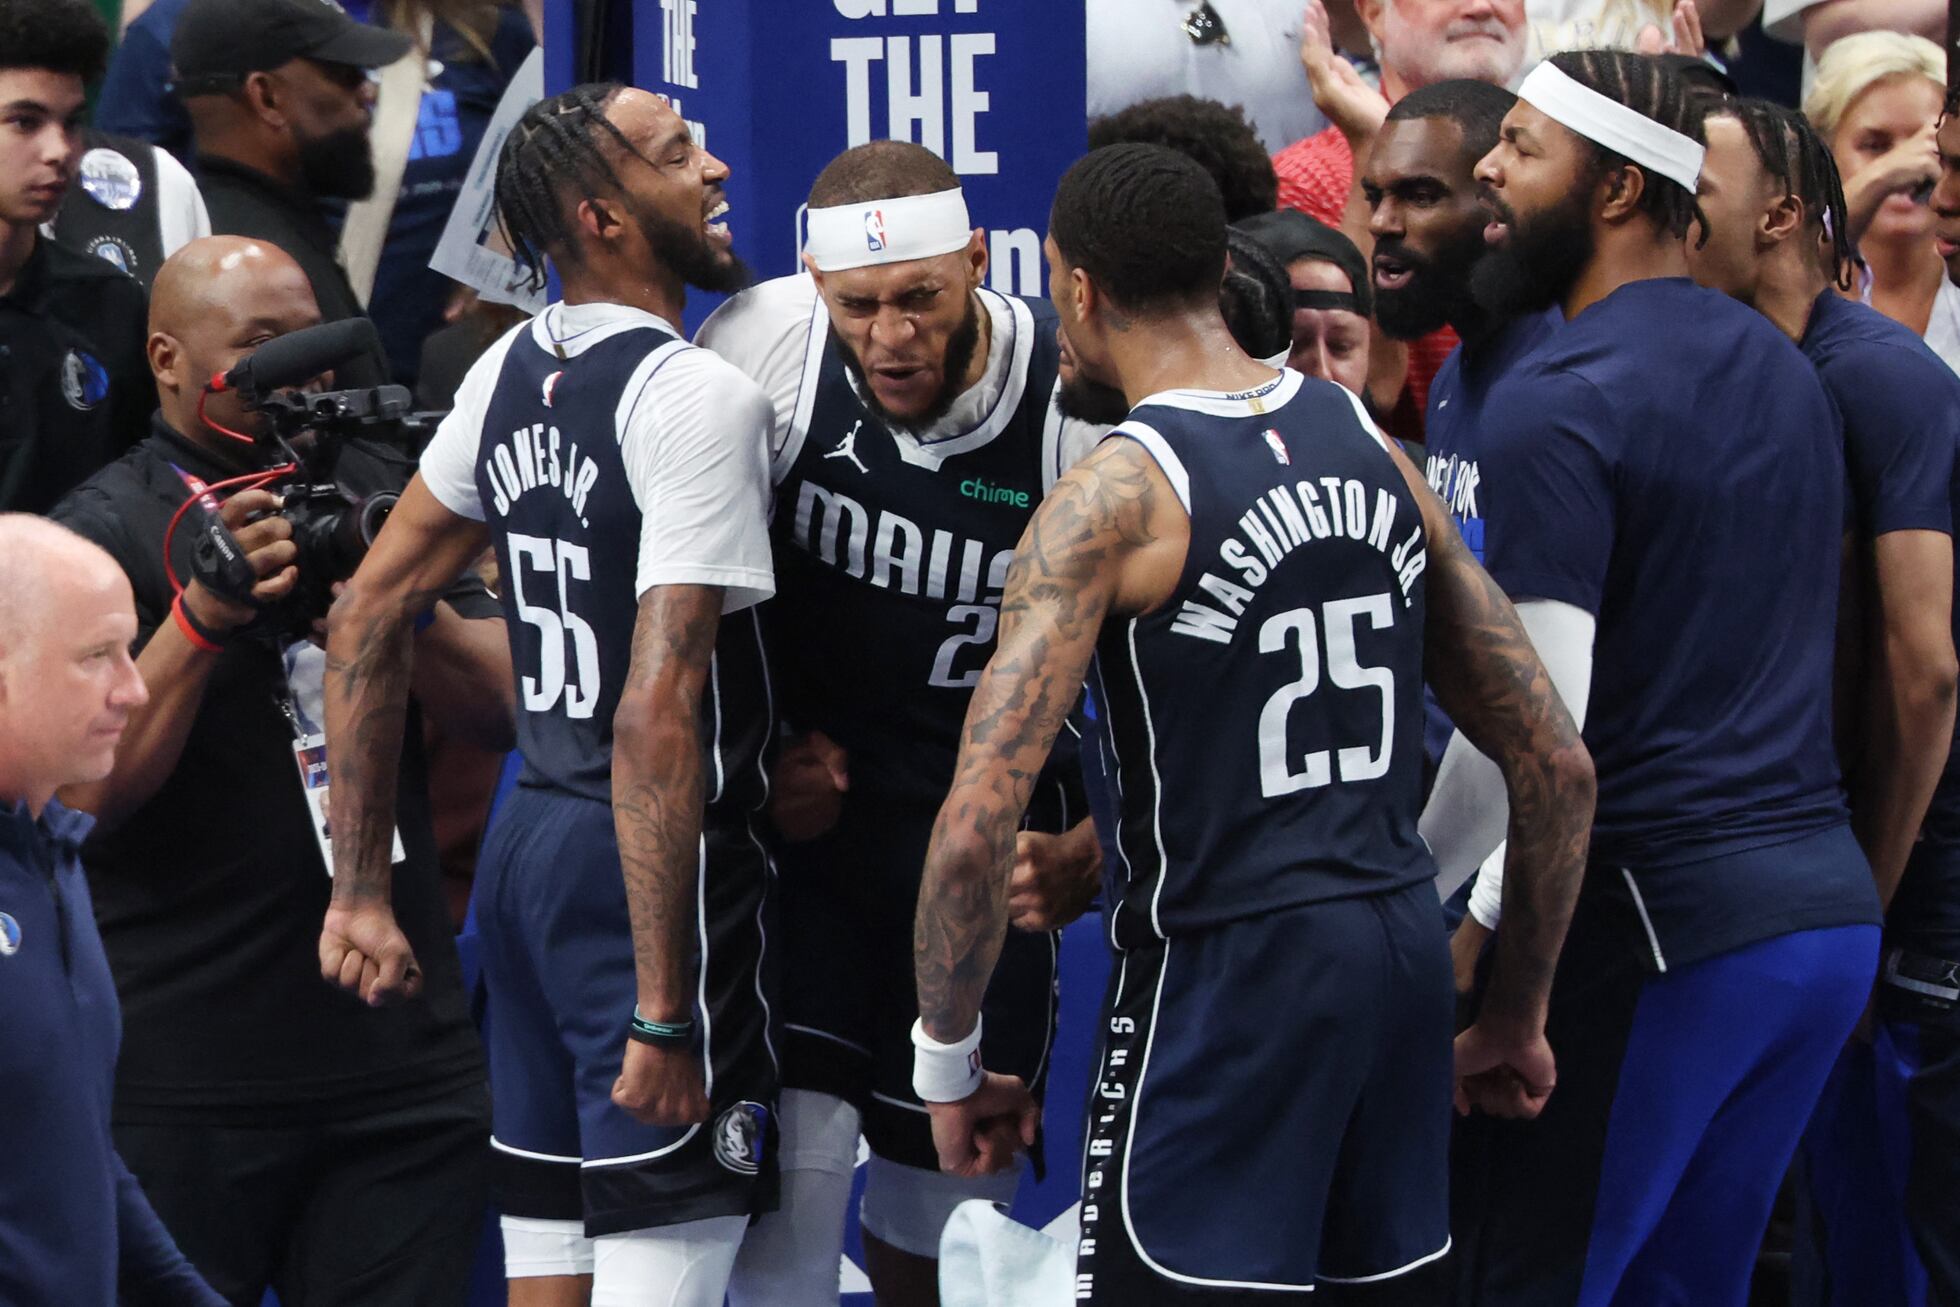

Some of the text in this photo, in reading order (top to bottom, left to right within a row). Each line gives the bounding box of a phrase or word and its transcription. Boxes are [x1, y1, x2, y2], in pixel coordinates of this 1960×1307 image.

[659, 0, 698, 89] THE
[830, 33, 998, 174] THE
[486, 423, 599, 528] JONES JR.
[960, 478, 1029, 508] chime
[210, 525, 236, 562] Canon
[1170, 477, 1396, 644] WASHINGTON
[1391, 525, 1426, 608] JR.
[507, 532, 600, 719] 55
[1258, 592, 1394, 797] 25
